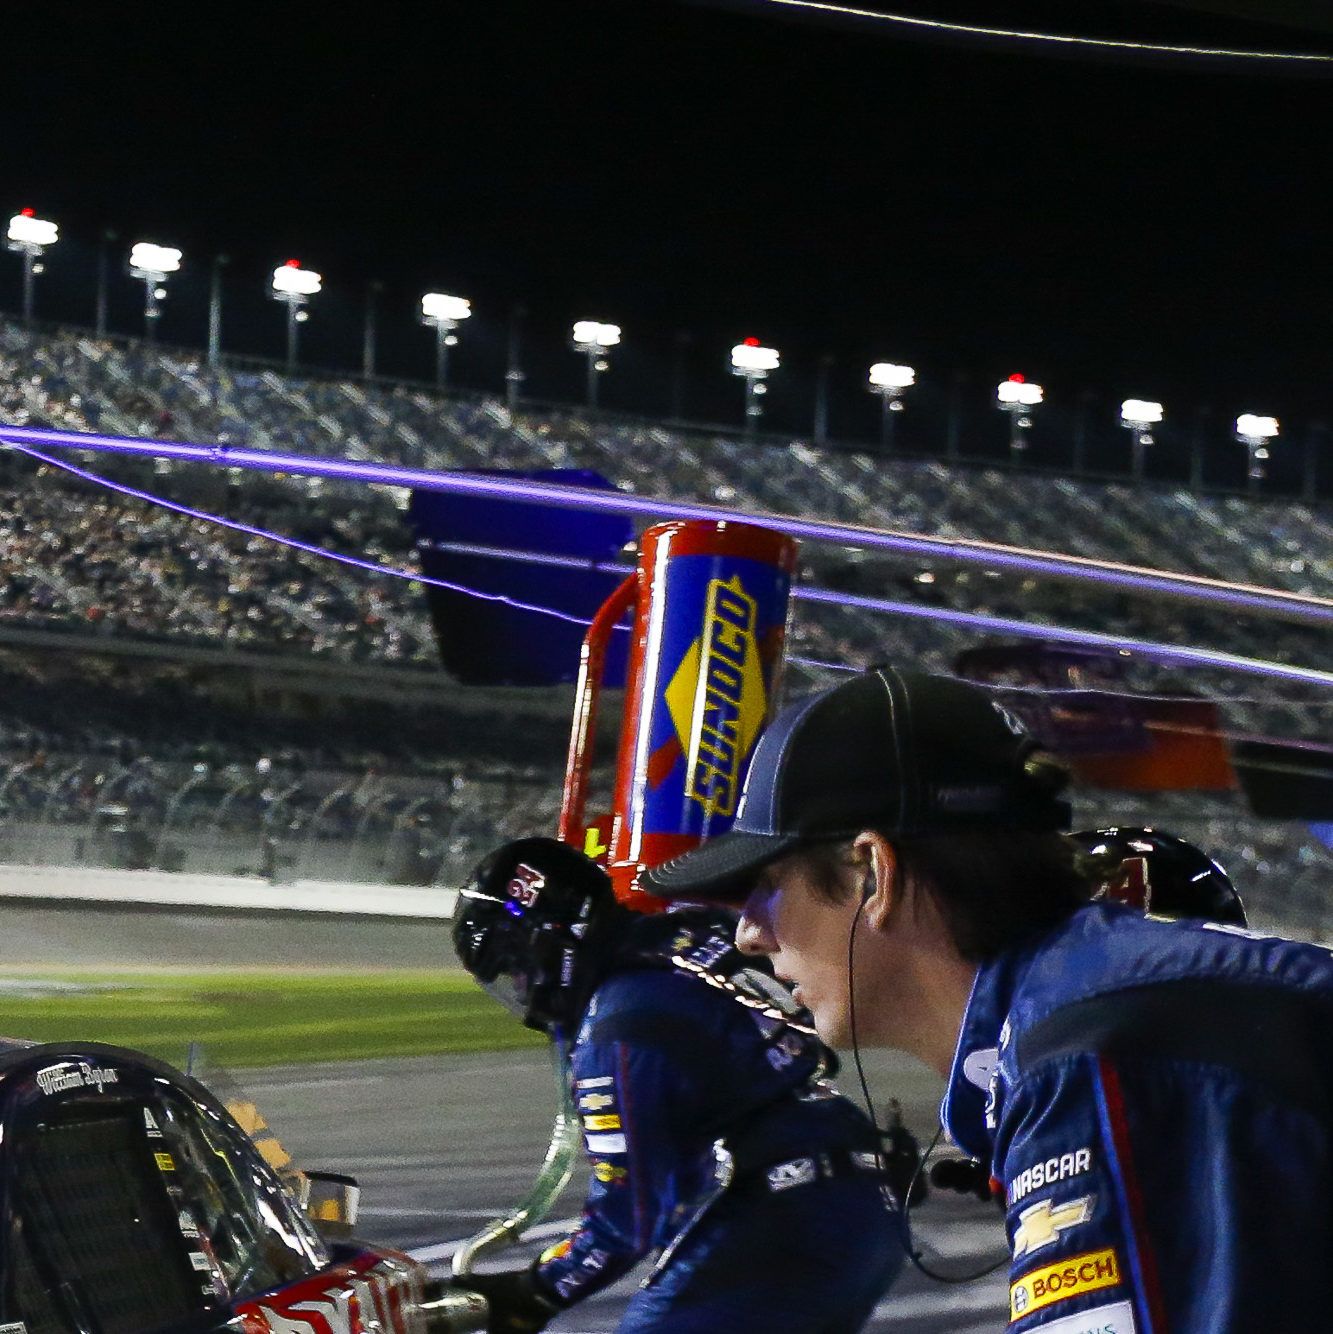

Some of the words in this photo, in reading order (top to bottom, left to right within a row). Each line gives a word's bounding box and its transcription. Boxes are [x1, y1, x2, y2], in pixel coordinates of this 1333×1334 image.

[690, 584, 757, 816] SUNOCO
[1012, 1147, 1091, 1203] NASCAR
[1033, 1257, 1114, 1300] BOSCH
